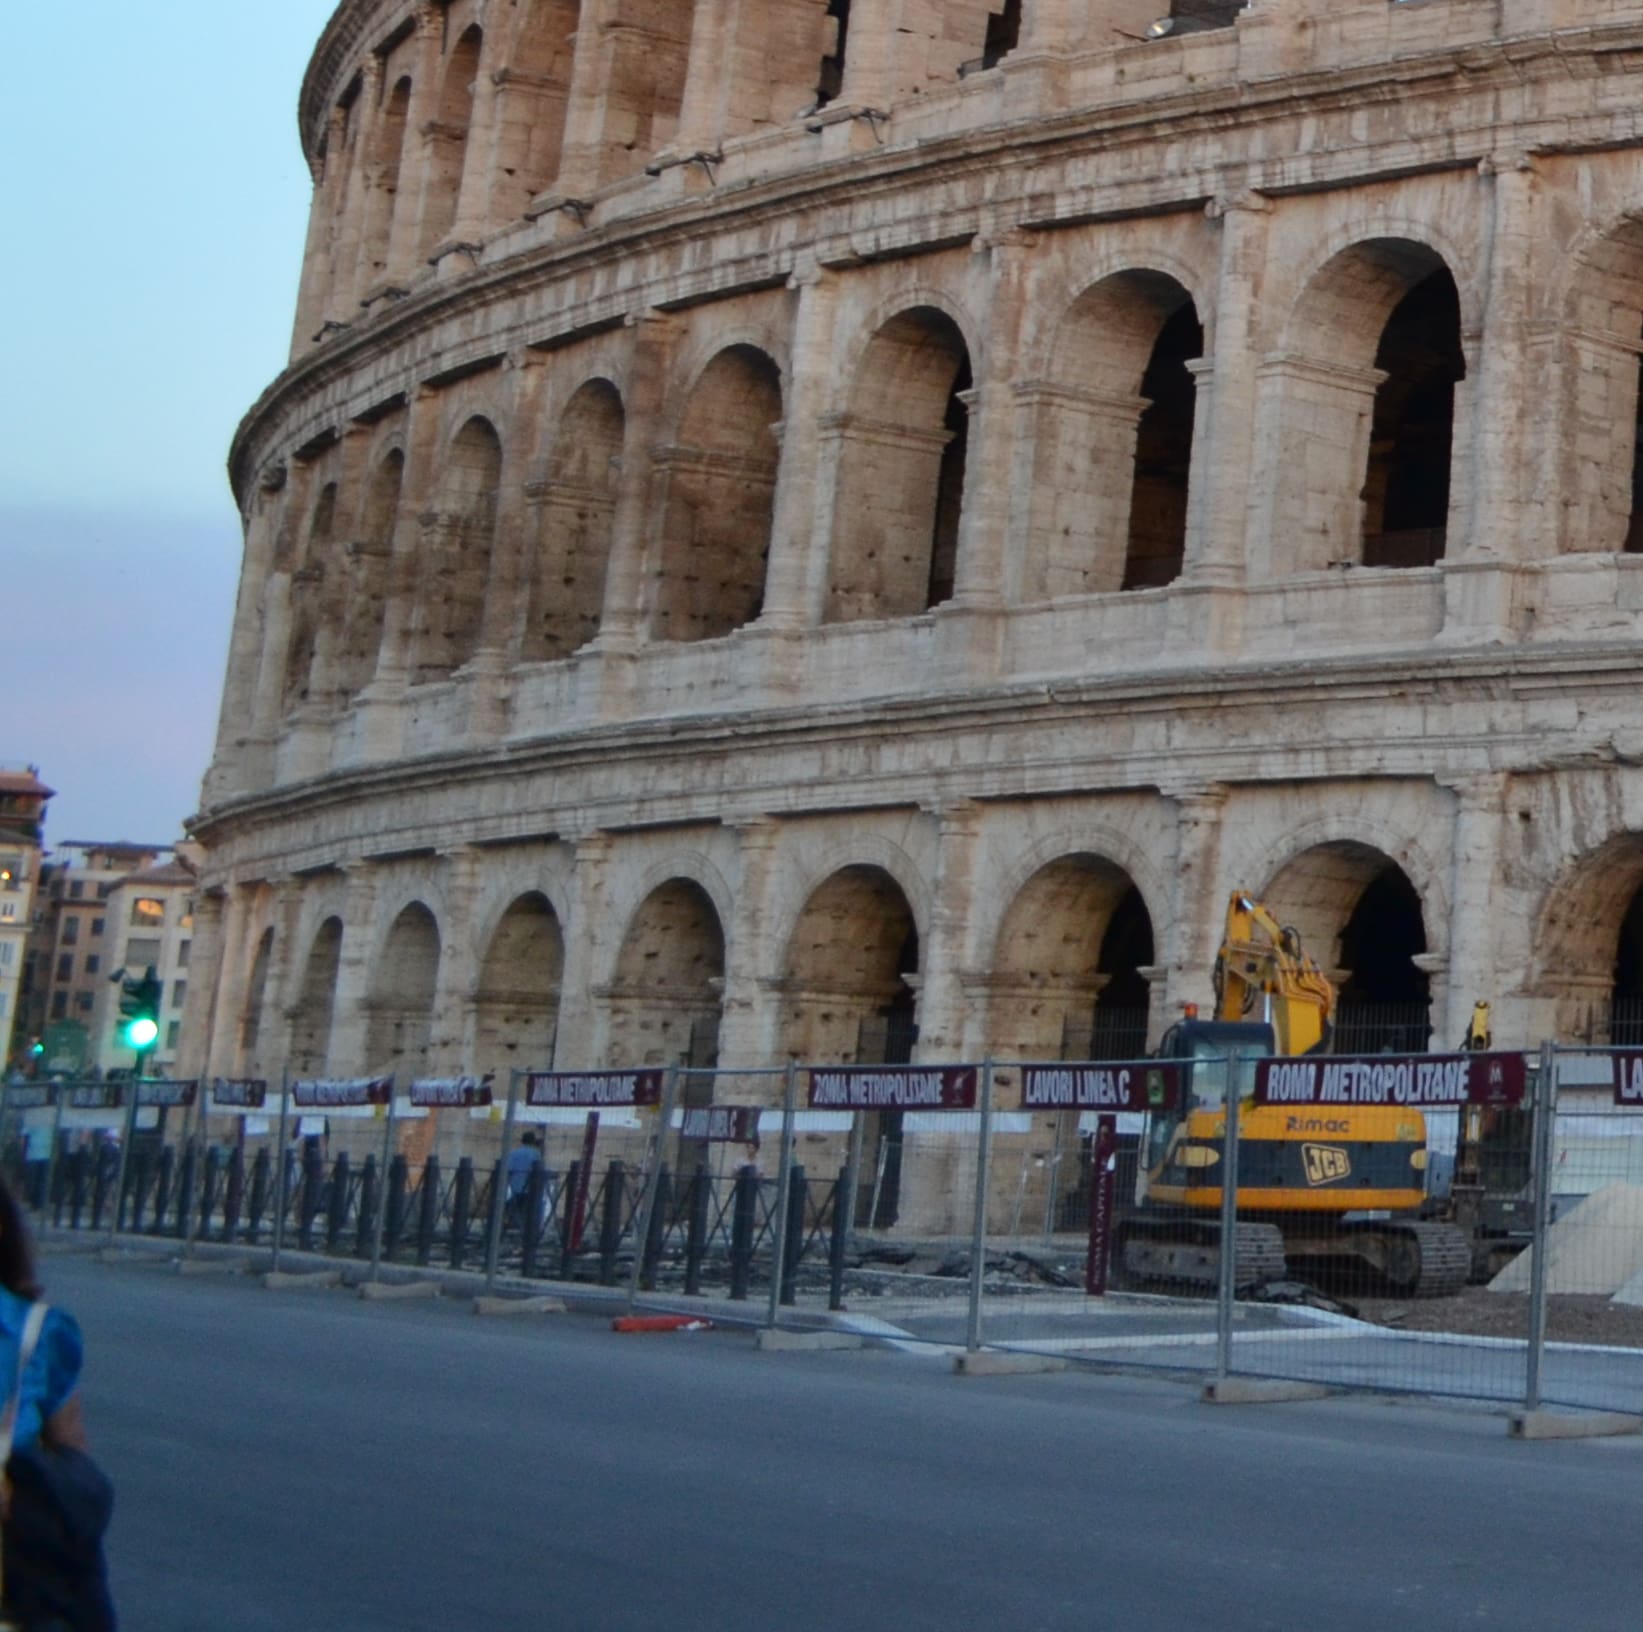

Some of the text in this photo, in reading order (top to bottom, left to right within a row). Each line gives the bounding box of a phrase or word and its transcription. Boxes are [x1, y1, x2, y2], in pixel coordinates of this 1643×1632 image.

[850, 1072, 944, 1105] METROPOLITANE
[1025, 1069, 1130, 1105] LAVORI LINEA C
[1266, 1060, 1472, 1102] ROMA METROPOLITANE
[1285, 1115, 1350, 1134] Rimac
[1308, 1147, 1347, 1182] JCB
